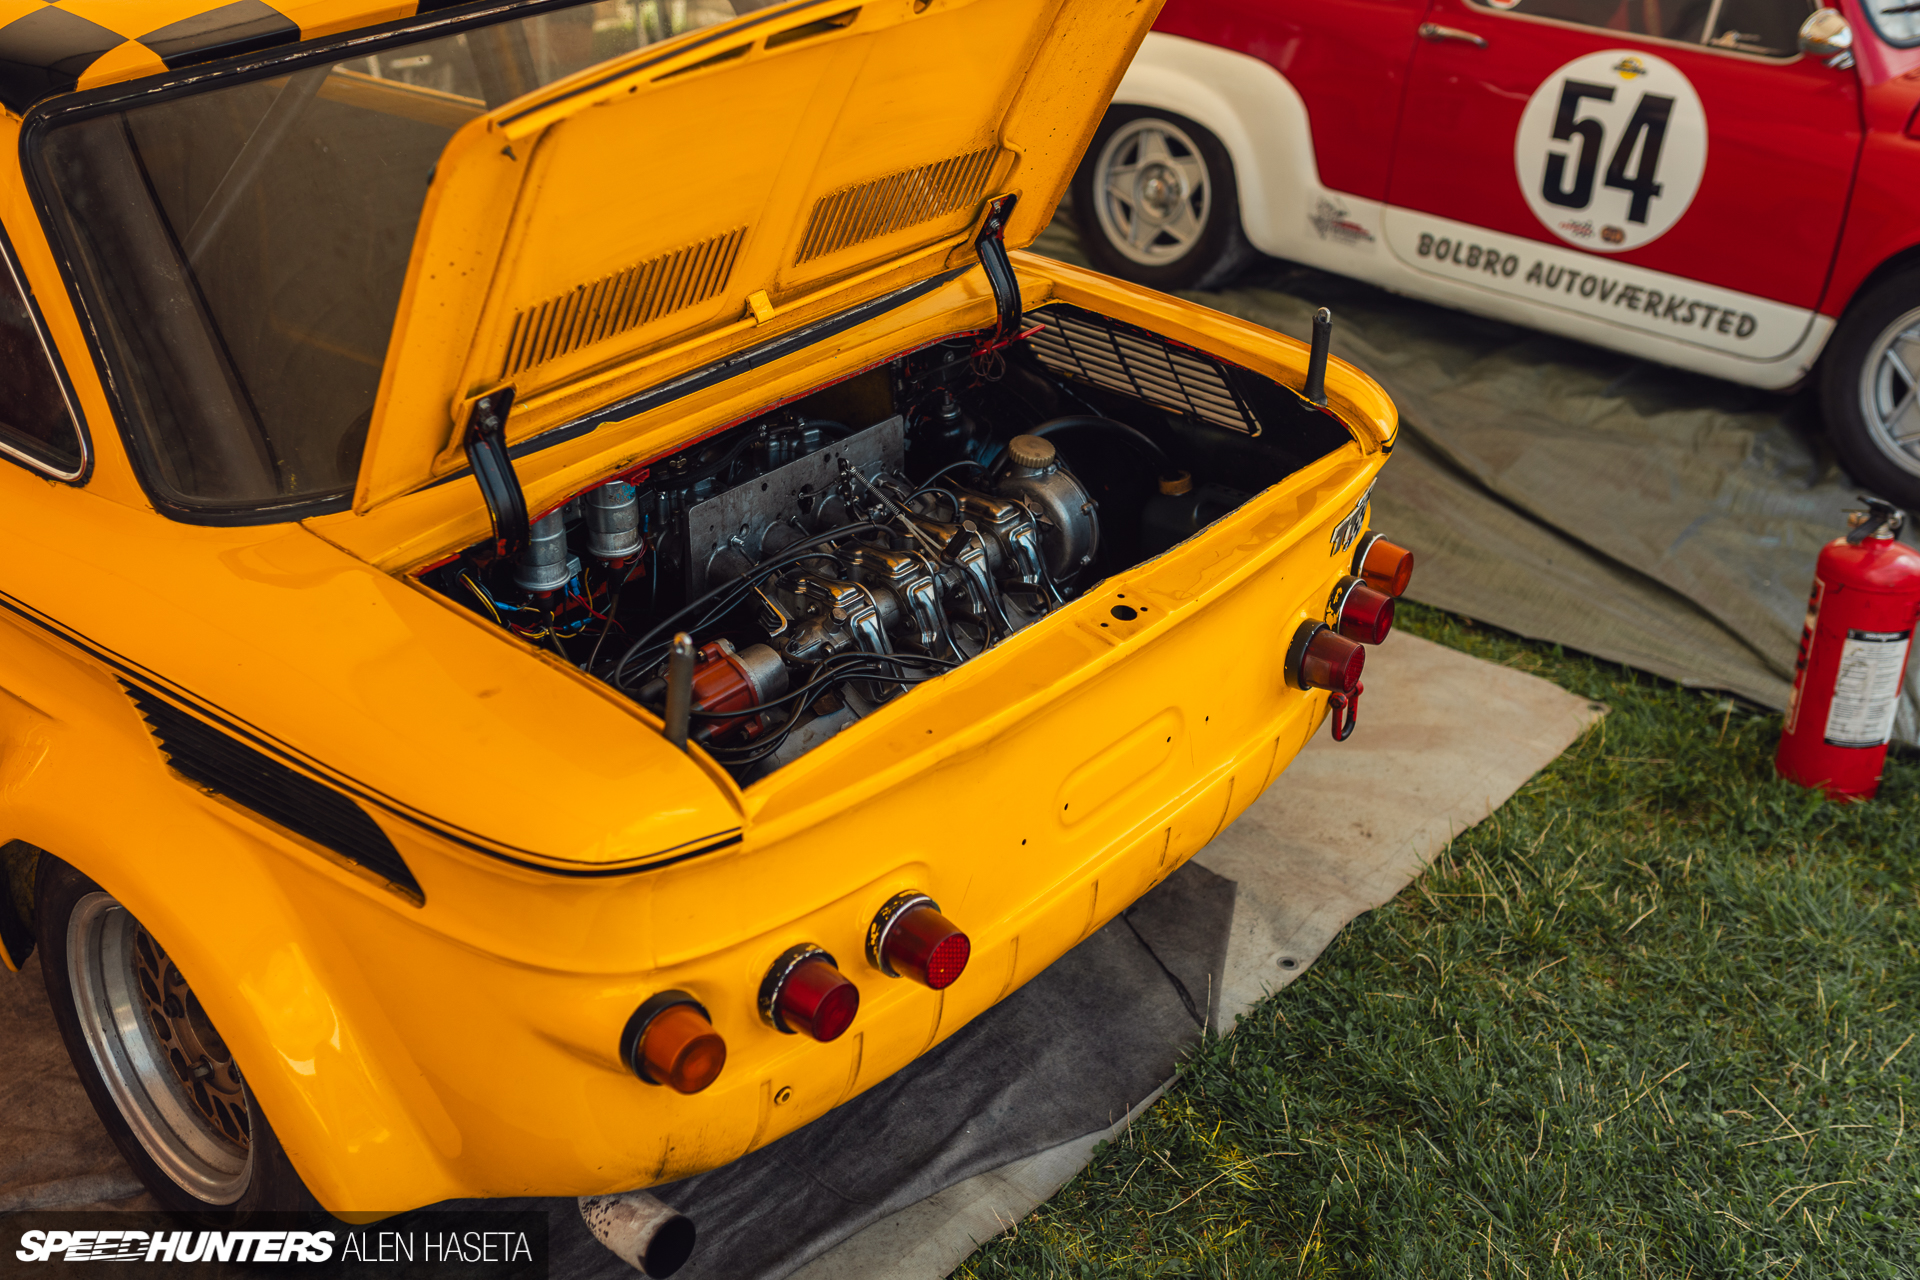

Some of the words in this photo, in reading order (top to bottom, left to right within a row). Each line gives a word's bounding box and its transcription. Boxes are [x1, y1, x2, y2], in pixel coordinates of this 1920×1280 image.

[1542, 79, 1676, 224] 54
[1417, 232, 1520, 277] BOLBRO
[1526, 261, 1757, 340] AUTOVÆRKSTED
